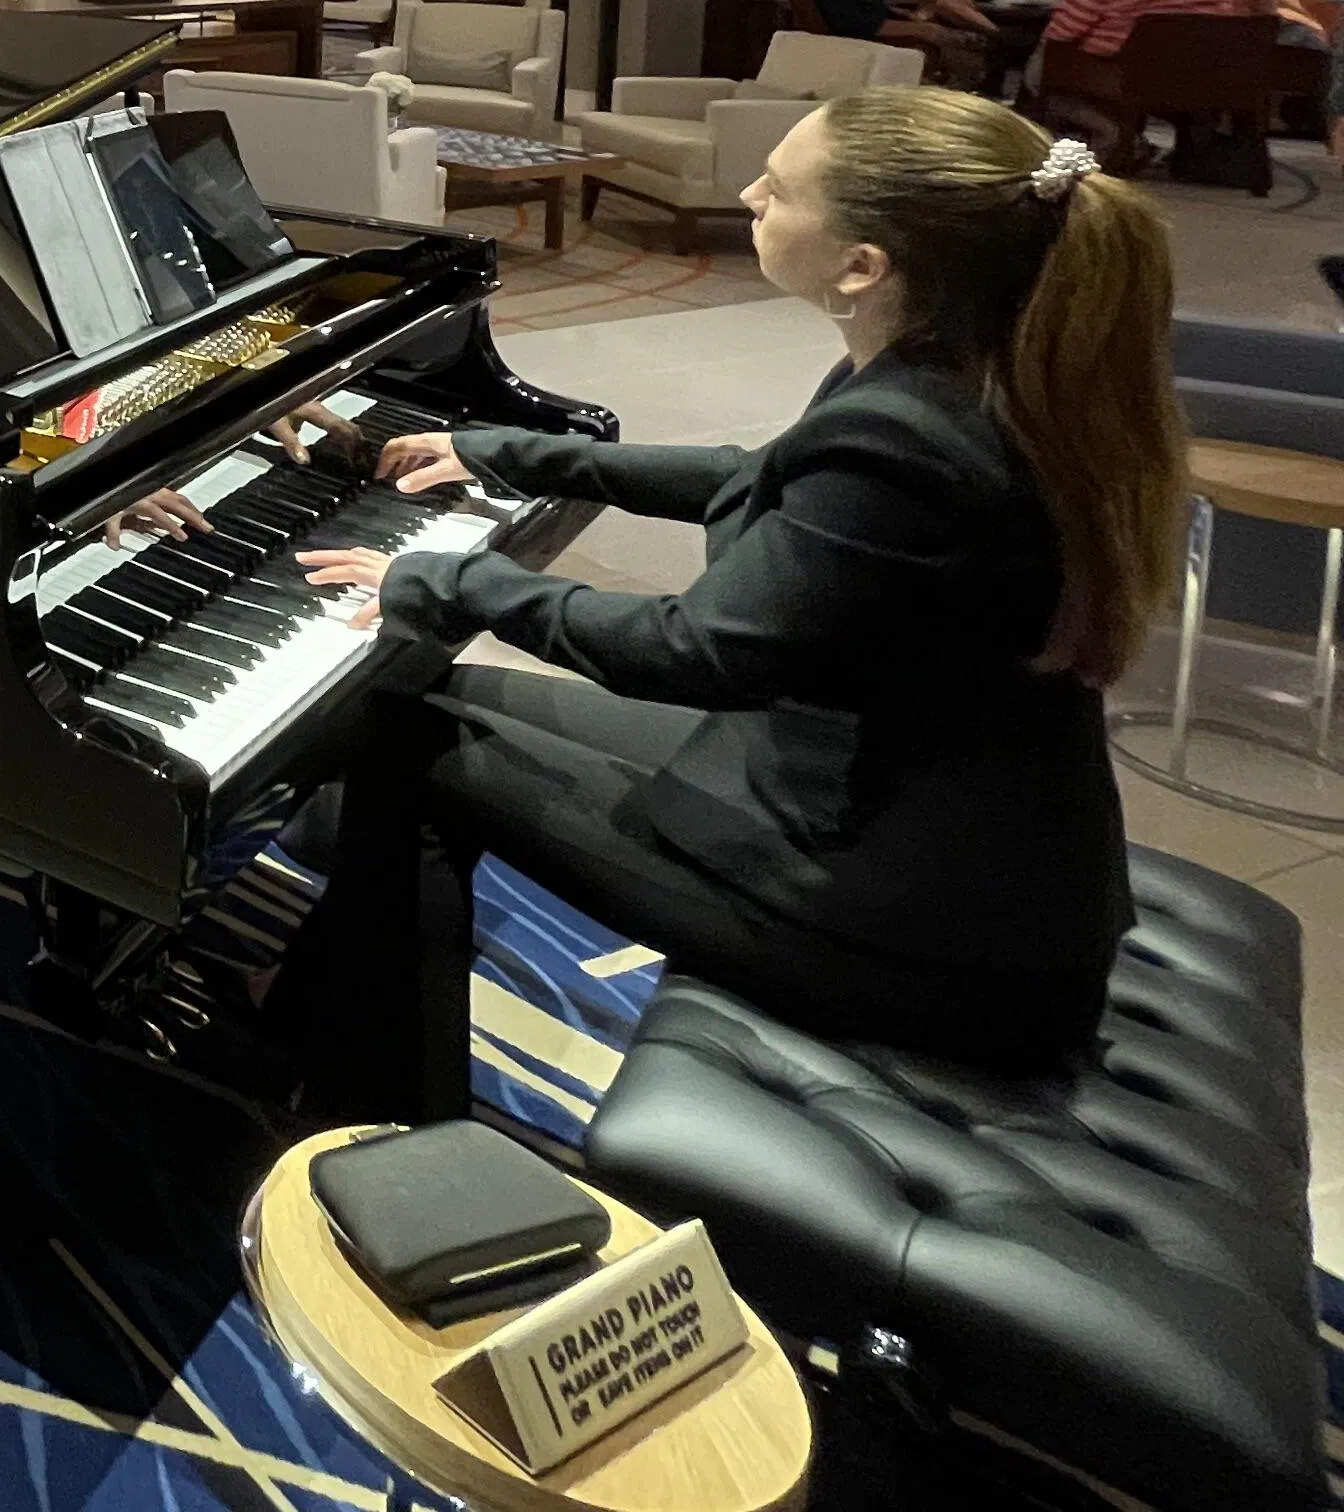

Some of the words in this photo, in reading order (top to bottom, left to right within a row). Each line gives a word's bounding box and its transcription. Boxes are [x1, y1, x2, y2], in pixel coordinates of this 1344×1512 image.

[546, 1307, 625, 1375] GRAND
[626, 1264, 694, 1326] PIANO
[559, 1357, 611, 1403] PLEASE
[608, 1344, 631, 1371] DO
[629, 1325, 659, 1357] NOT
